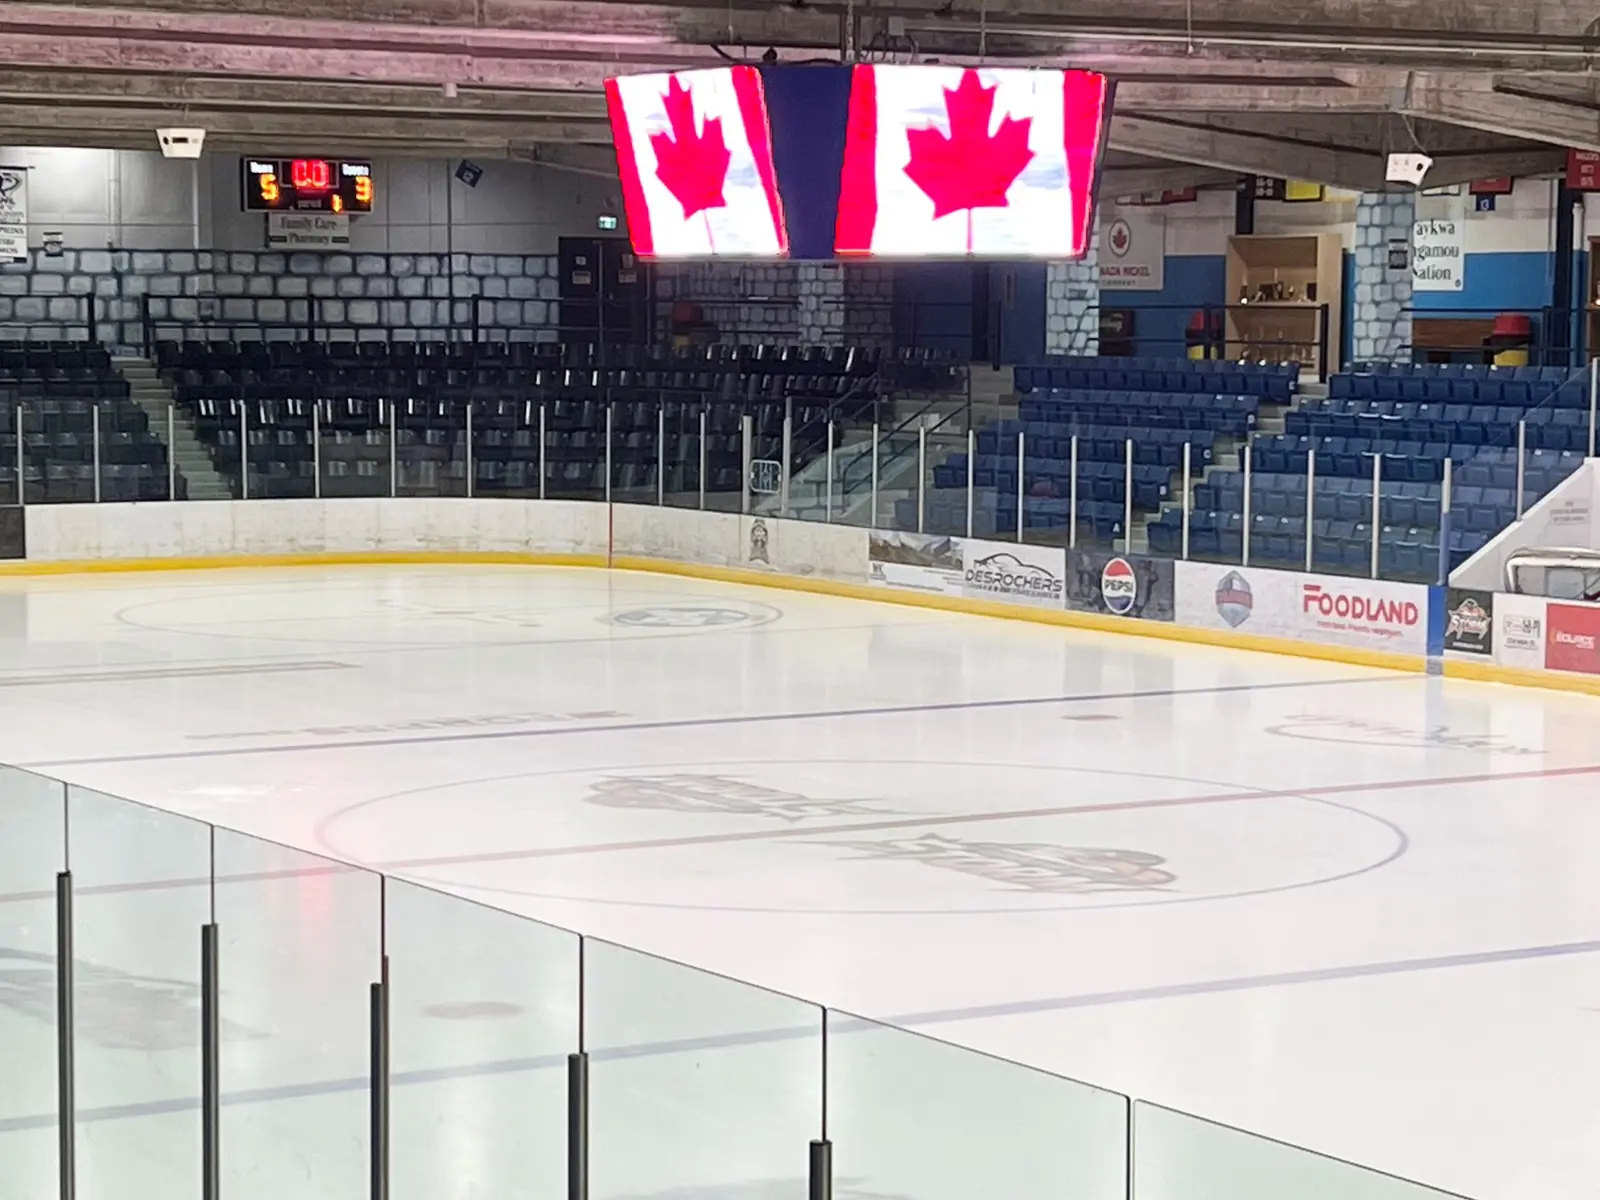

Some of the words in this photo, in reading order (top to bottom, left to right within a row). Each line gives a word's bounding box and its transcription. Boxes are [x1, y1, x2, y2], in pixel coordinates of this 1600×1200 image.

[260, 173, 279, 201] 5
[355, 175, 372, 202] 3
[281, 217, 313, 233] Family
[315, 217, 337, 230] Care
[1416, 218, 1455, 236] aykwa
[288, 232, 330, 245] Pharmacy
[1203, 449, 1212, 459] C
[1112, 522, 1121, 533] A
[964, 569, 1063, 592] DESROCHERS
[1104, 579, 1133, 593] PEPSI
[1303, 583, 1418, 626] FOODLAND
